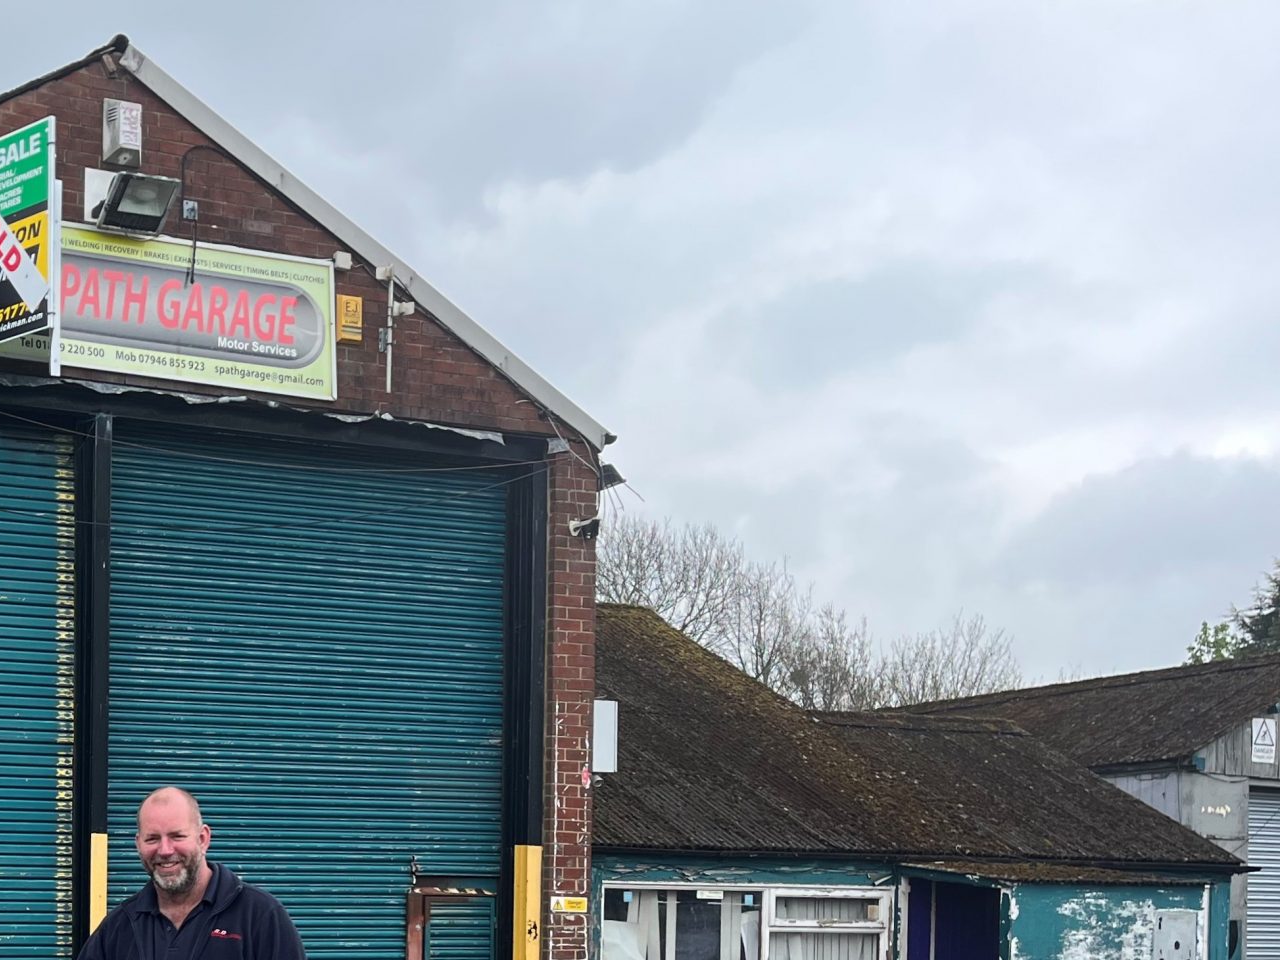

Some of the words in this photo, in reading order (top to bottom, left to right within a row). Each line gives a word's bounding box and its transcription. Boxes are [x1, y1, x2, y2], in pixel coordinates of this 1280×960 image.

[68, 240, 101, 250] WELDING
[104, 243, 140, 255] RECOVERY
[143, 251, 170, 261] BRAKES
[212, 260, 242, 272] SERVICES
[246, 266, 270, 276] TIMING
[270, 271, 289, 279] BELTS
[292, 273, 325, 285] CLUTCHES
[157, 277, 299, 346] GARAGE
[20, 336, 34, 348] Tel
[67, 343, 85, 355] 220
[87, 347, 105, 358] 500
[115, 350, 136, 362] Mob
[138, 354, 167, 366] 07946
[169, 358, 186, 369] 855
[188, 360, 205, 371] 923
[214, 364, 324, 386] spathgarage@gmail.com
[217, 336, 249, 351] Motor
[251, 341, 298, 357] Services
